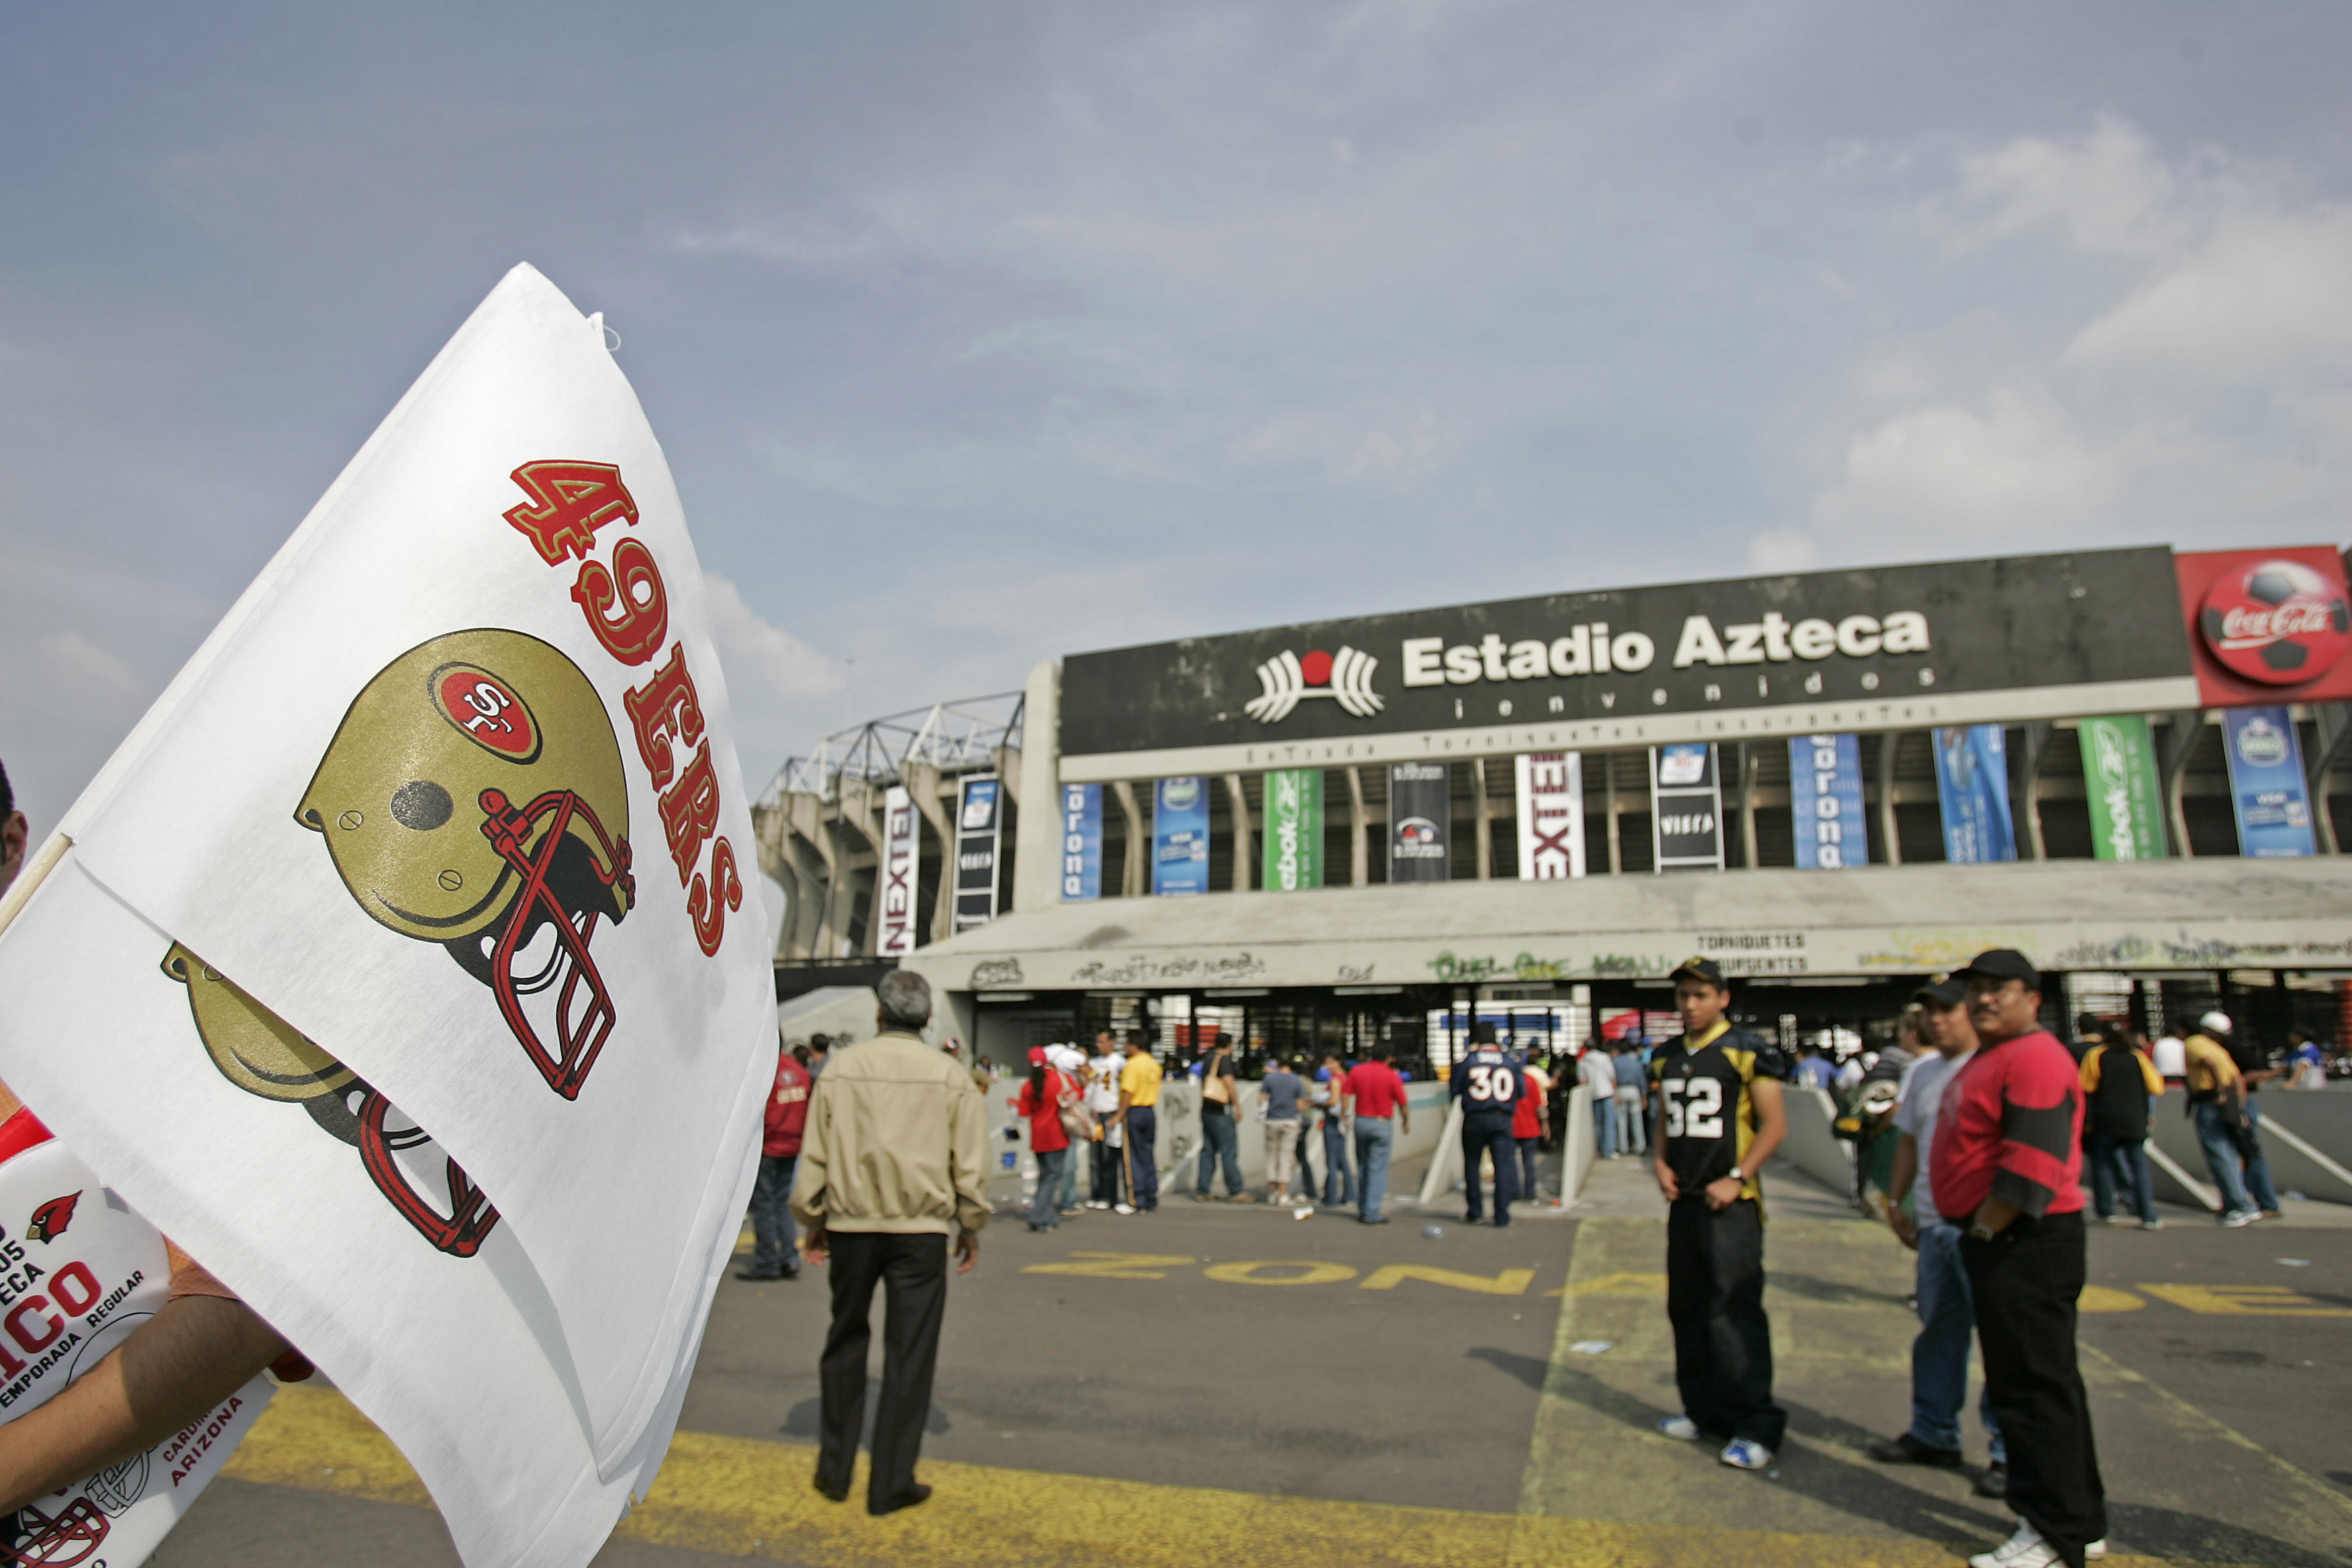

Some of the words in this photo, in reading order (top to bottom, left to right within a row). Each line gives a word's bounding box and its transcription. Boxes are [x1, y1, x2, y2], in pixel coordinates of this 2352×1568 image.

[1401, 621, 1655, 688] Estadio
[1671, 610, 1931, 669] Azteca
[501, 459, 742, 958] 49ERS
[1469, 1065, 1514, 1102] 30
[1661, 1076, 1723, 1138] 52
[0, 1261, 101, 1388] ICO
[0, 1332, 82, 1408] EMPORADA
[86, 1270, 144, 1328] REGULAR
[171, 1397, 243, 1487] ARIZONA
